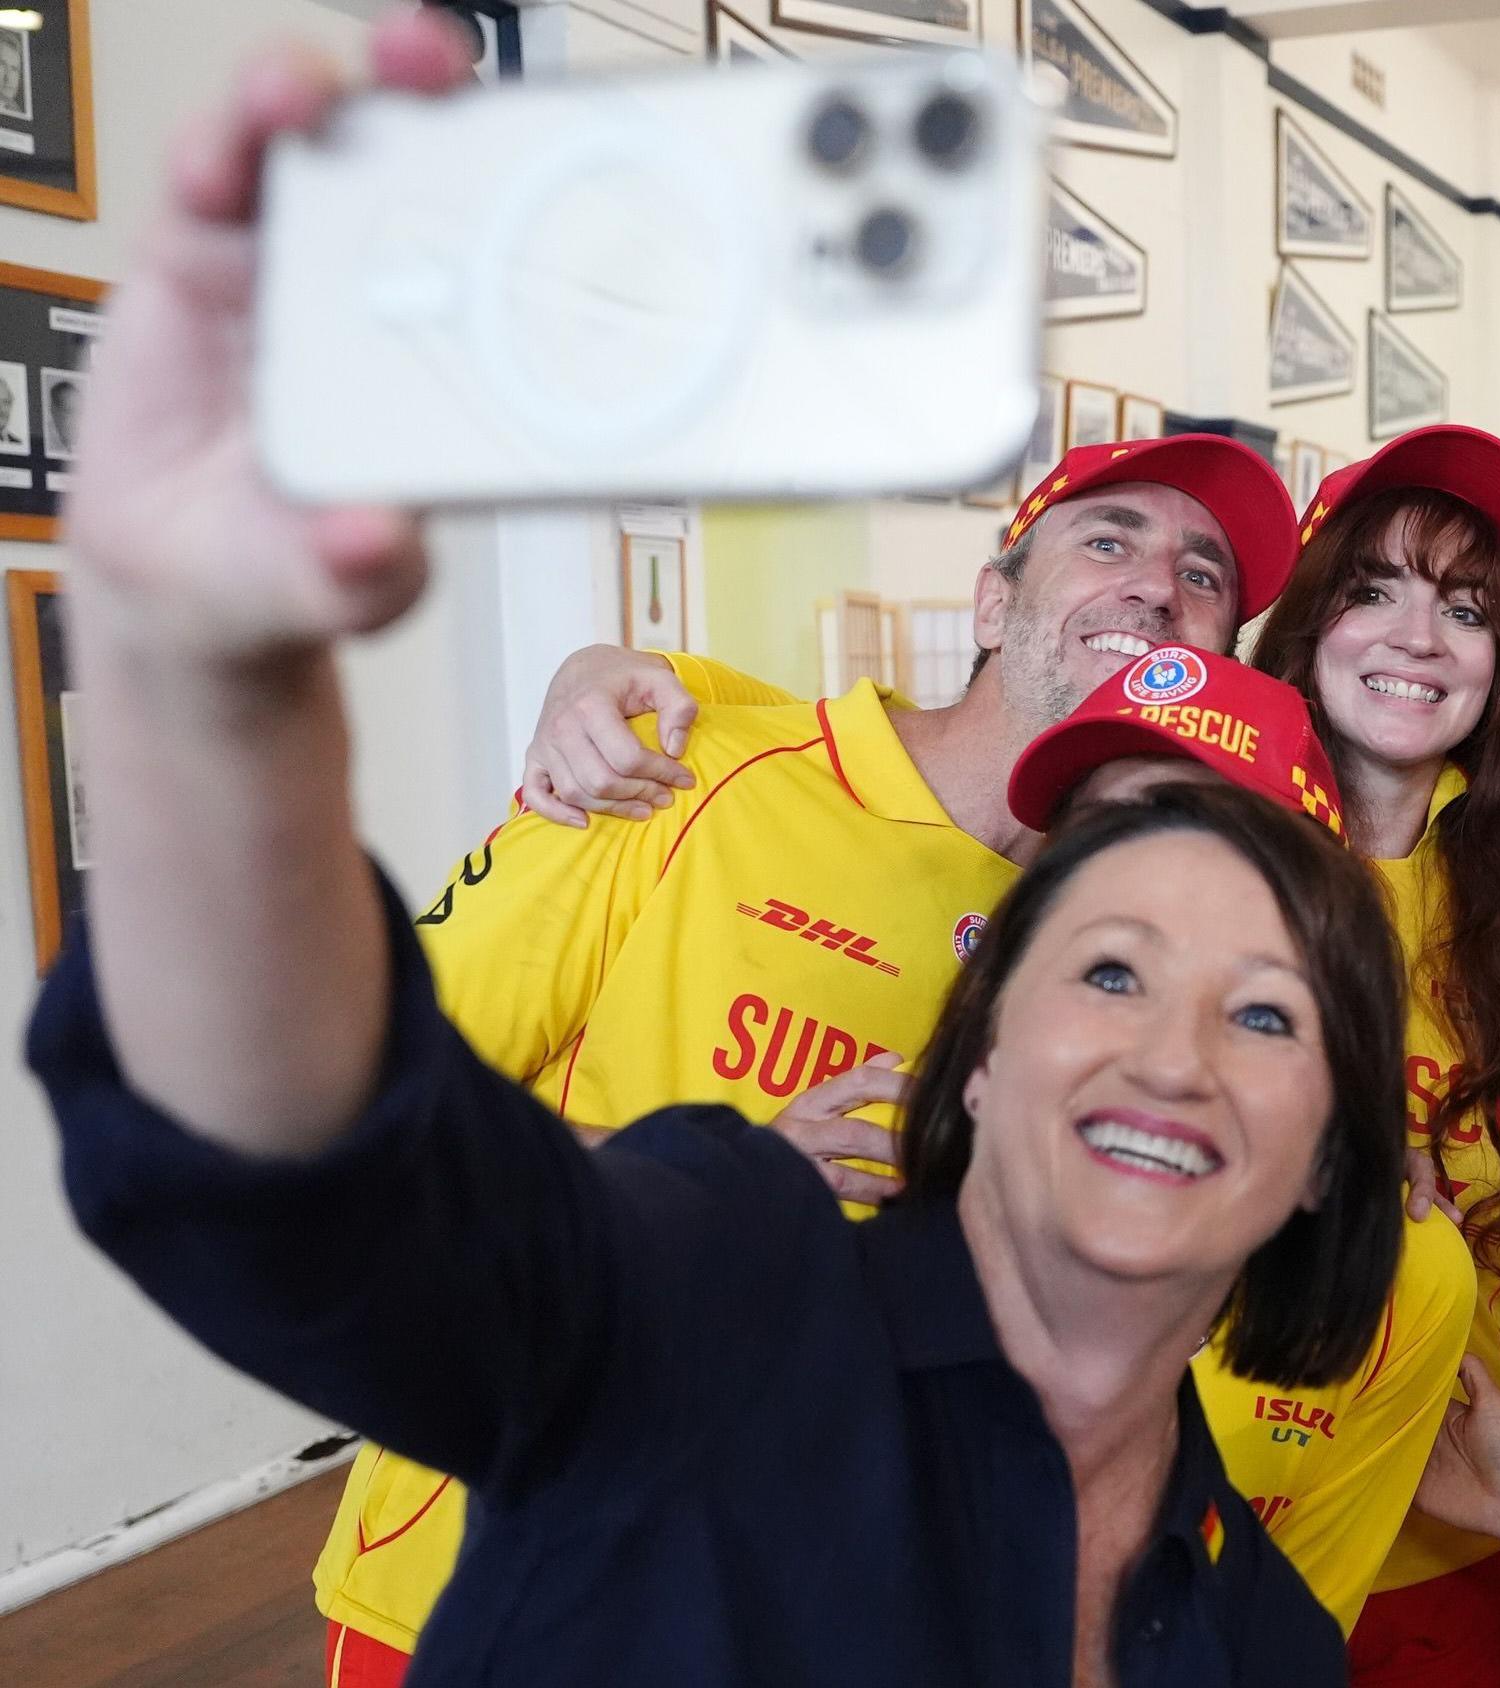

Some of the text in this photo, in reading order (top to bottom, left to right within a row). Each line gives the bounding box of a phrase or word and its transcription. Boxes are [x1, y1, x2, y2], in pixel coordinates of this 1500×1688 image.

[1151, 651, 1189, 662] SURF
[1131, 676, 1197, 699] LIFE SAVING
[758, 898, 882, 967] DHL
[712, 993, 891, 1098] SUR
[1271, 1427, 1312, 1448] UT
